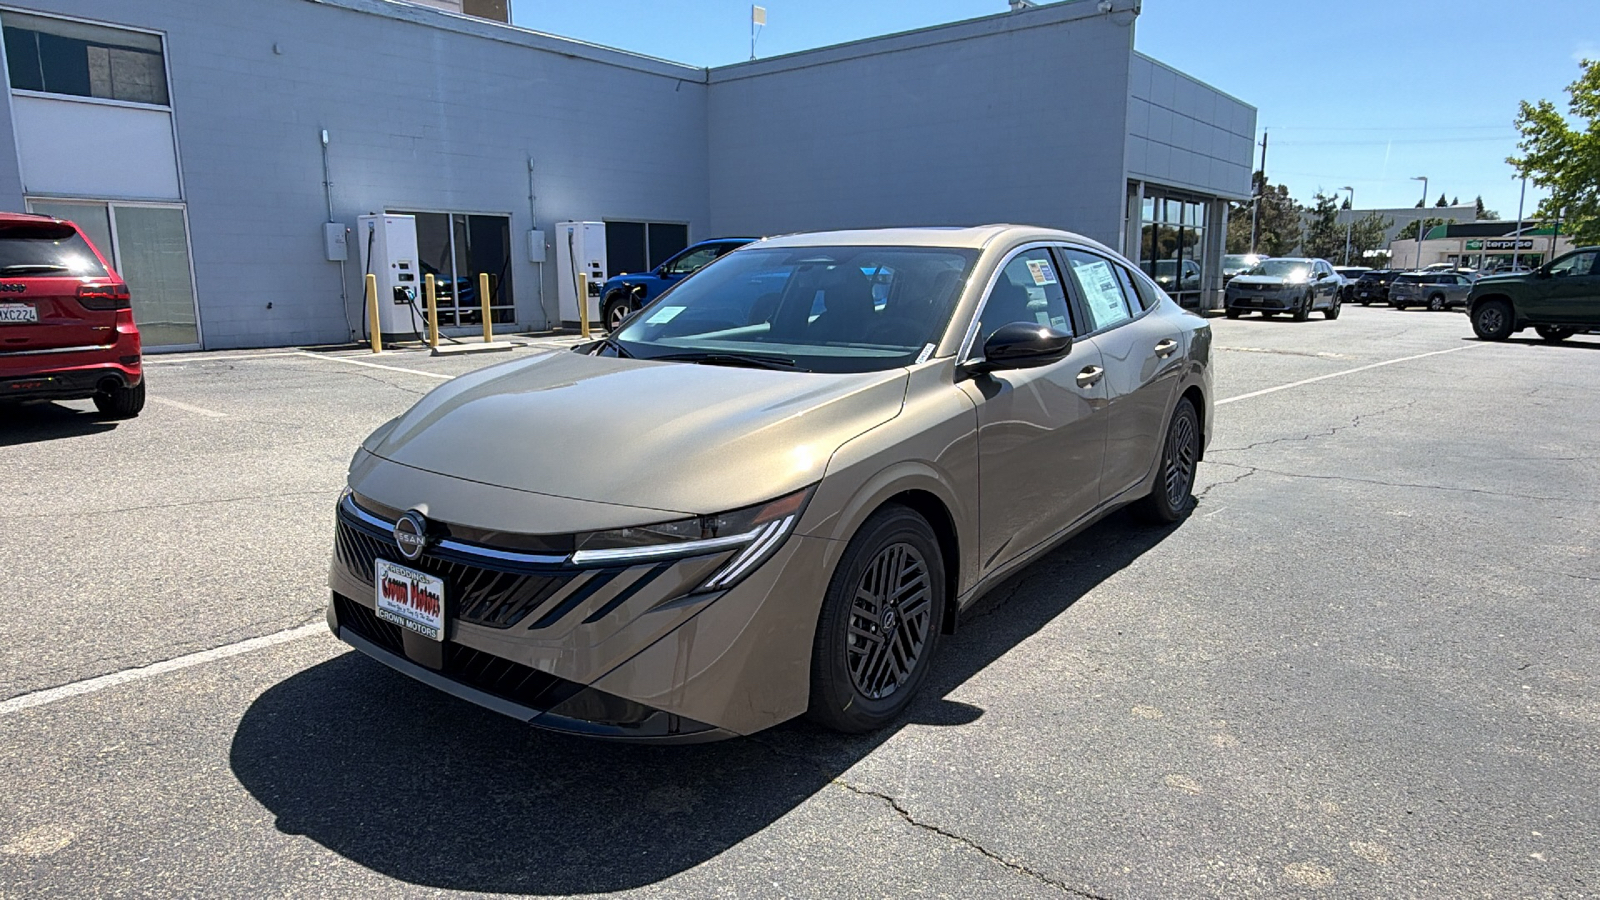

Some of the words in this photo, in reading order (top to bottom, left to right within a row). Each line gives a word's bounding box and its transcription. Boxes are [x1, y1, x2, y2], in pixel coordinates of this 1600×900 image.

[1470, 241, 1532, 249] eterprse
[0, 283, 27, 293] eep
[398, 532, 424, 544] SSAN
[389, 565, 425, 582] REDDING
[380, 610, 404, 625] CROWN
[406, 620, 436, 638] MOTORS
